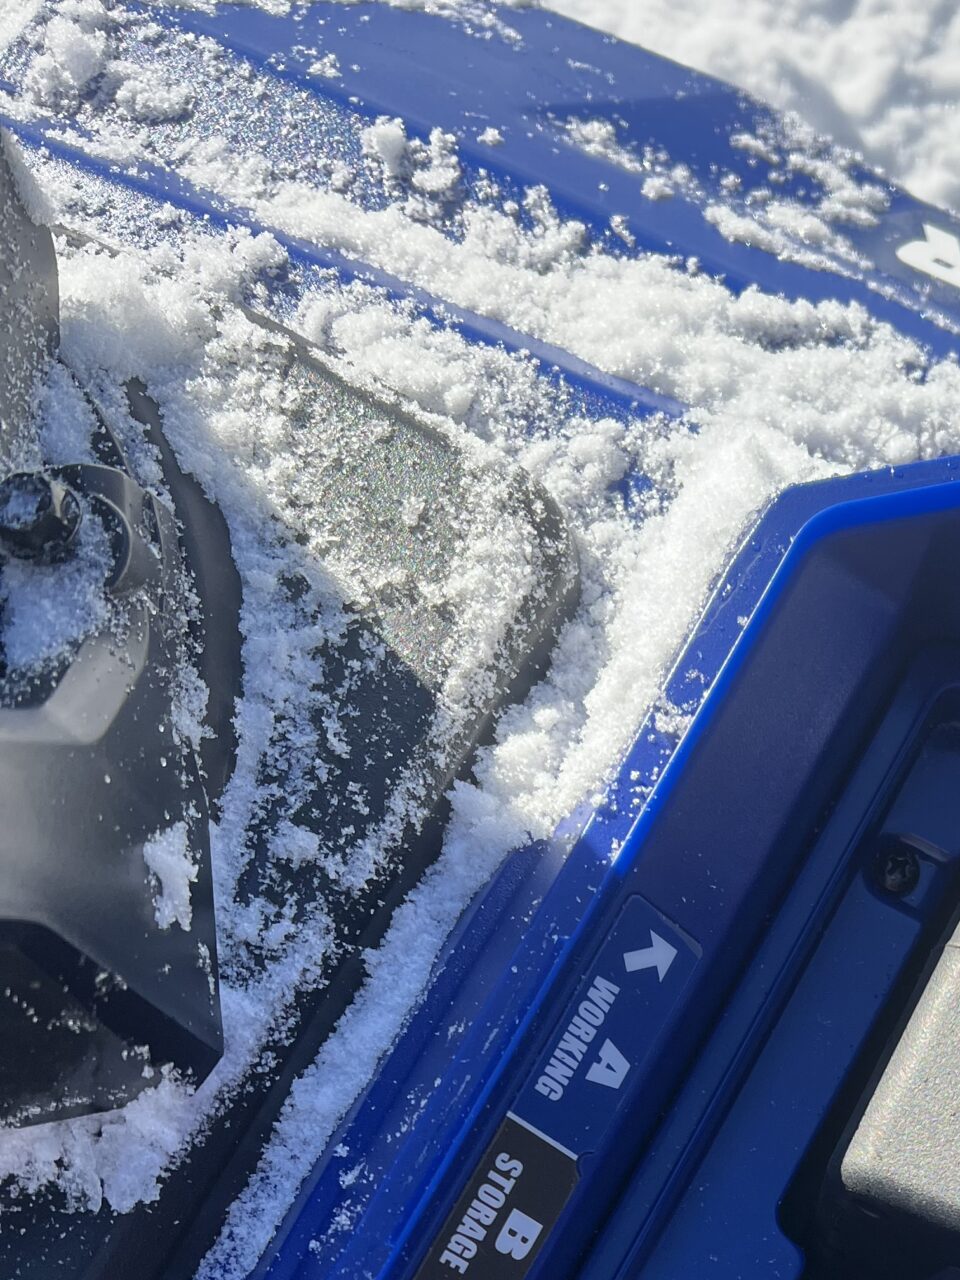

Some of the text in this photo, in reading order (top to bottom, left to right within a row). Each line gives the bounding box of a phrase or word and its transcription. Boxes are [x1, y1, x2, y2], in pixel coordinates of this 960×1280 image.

[534, 976, 620, 1101] WORKING
[585, 1038, 631, 1089] A
[439, 1152, 523, 1274] STORAGE
[495, 1208, 544, 1260] B
